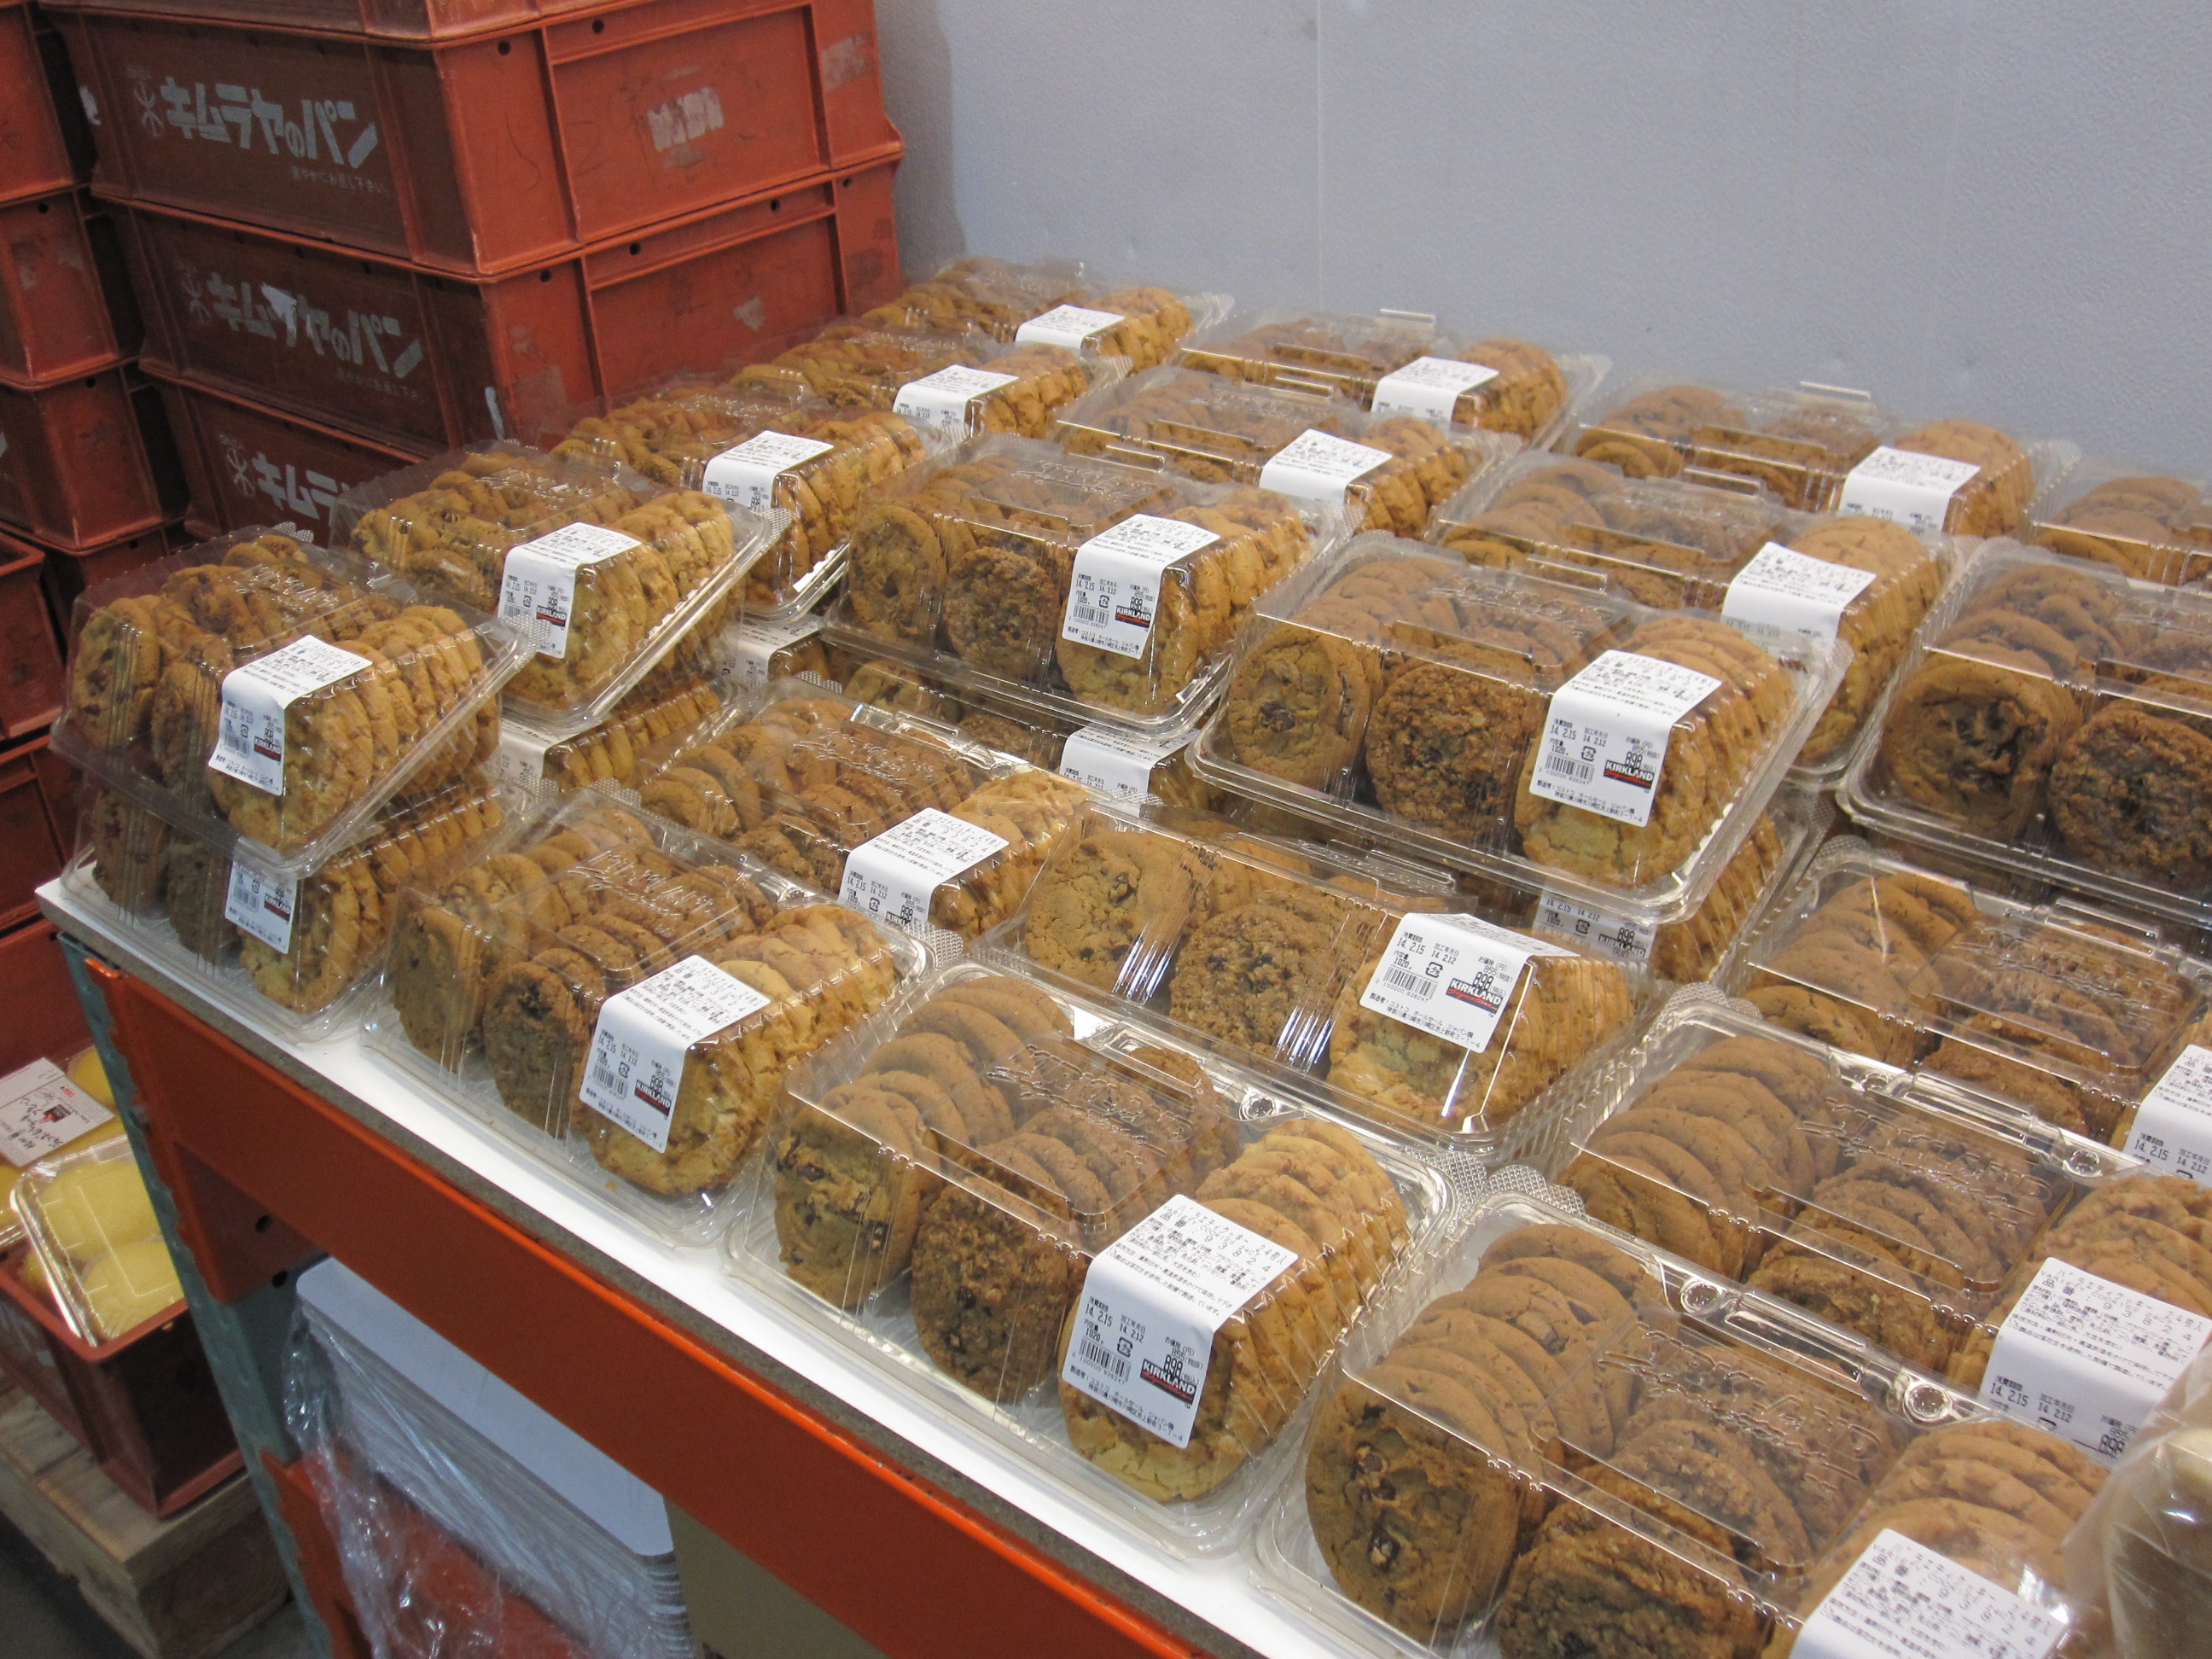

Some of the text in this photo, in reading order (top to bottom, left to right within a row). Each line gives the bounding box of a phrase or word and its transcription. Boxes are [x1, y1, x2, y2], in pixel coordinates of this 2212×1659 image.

[1117, 606, 1151, 620] KIRKLAND
[1606, 761, 1654, 781] KIRKLAND
[1450, 979, 1502, 1005] KIRKLAND
[637, 1080, 672, 1108] KIRKLAND
[1144, 1360, 1196, 1396] KIRKLAND
